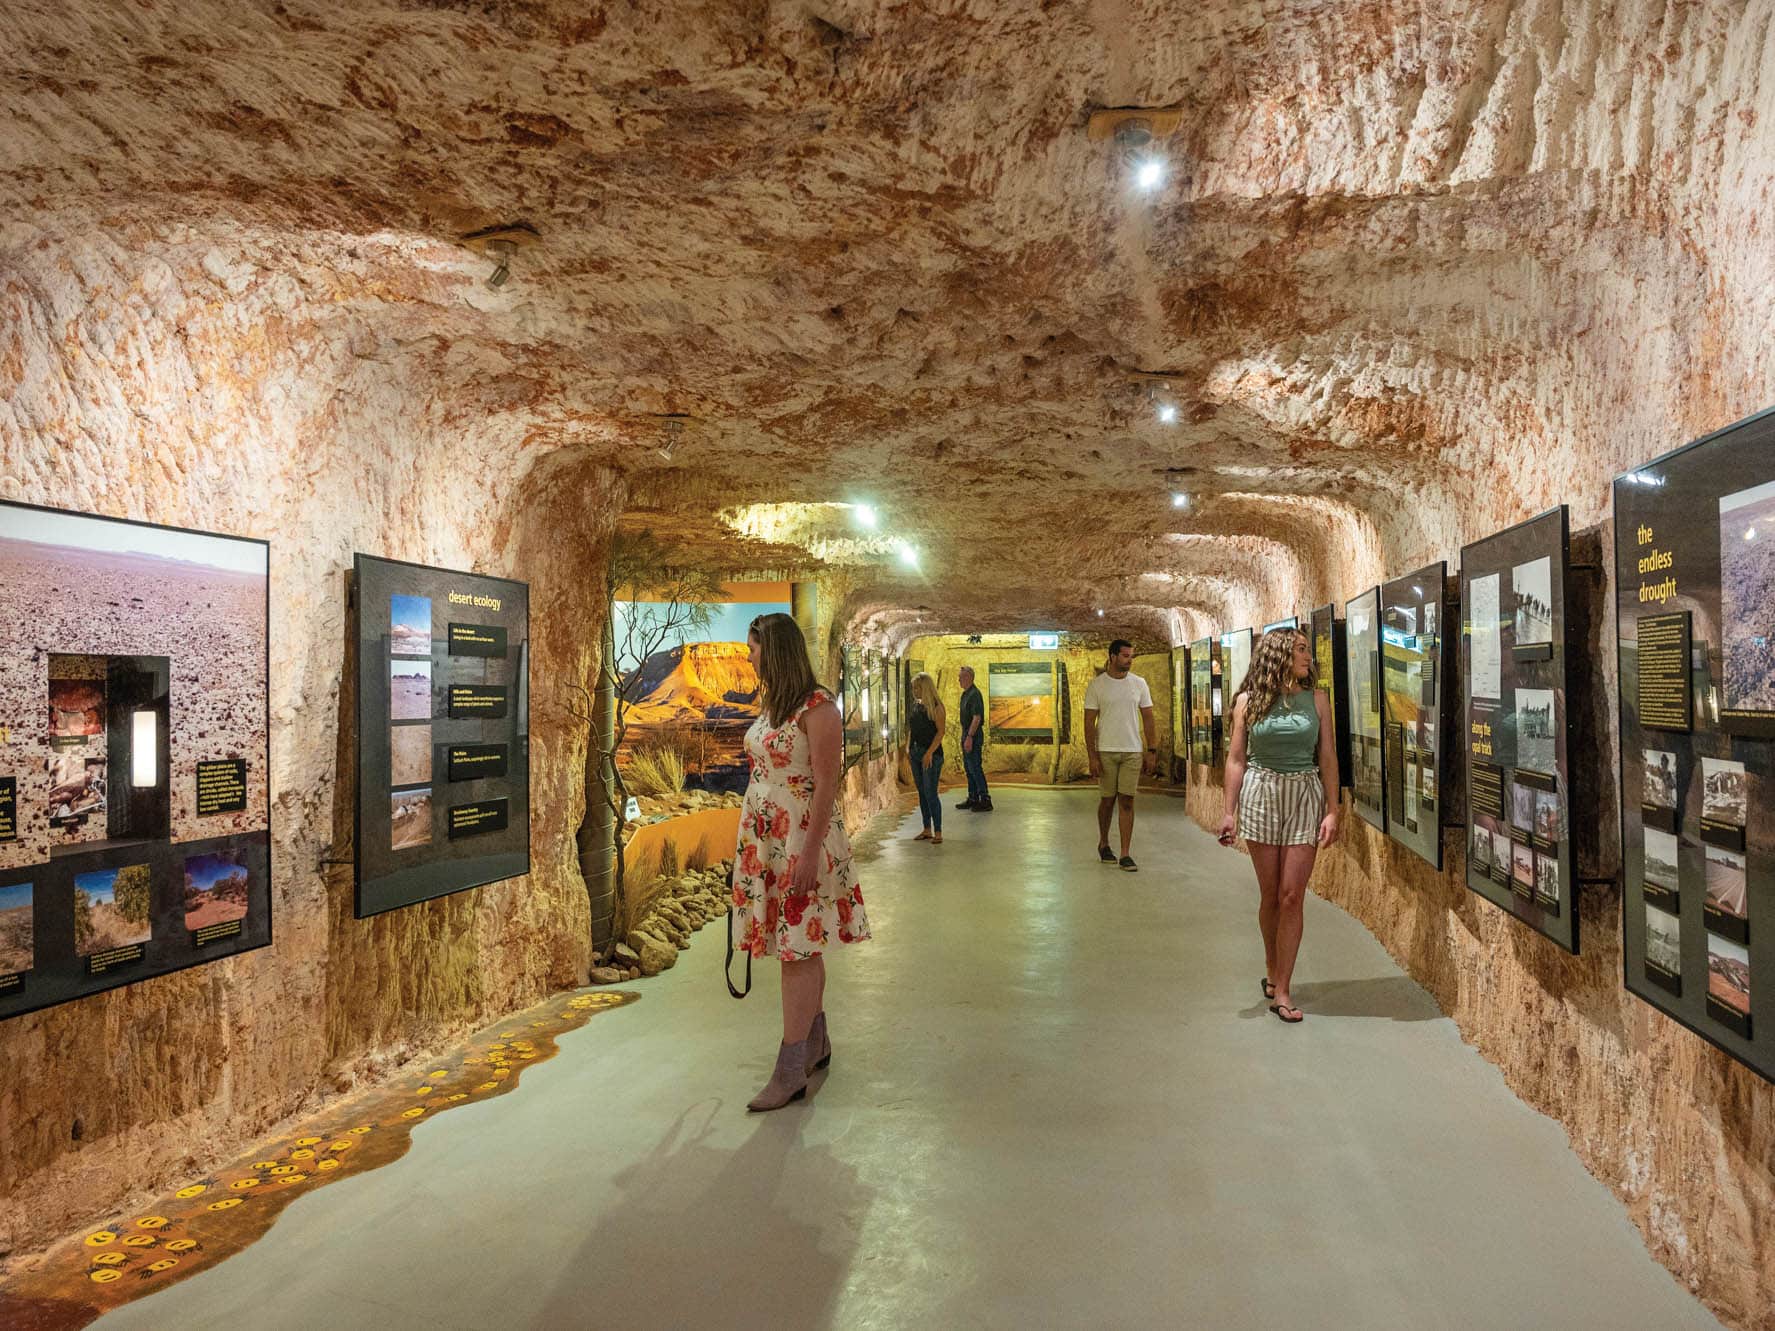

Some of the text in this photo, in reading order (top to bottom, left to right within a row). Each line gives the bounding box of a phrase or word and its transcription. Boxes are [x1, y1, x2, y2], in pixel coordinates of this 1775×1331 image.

[1637, 524, 1654, 546] the
[1638, 550, 1673, 574] endless
[448, 590, 502, 612] desert ecology
[1639, 576, 1677, 605] drought
